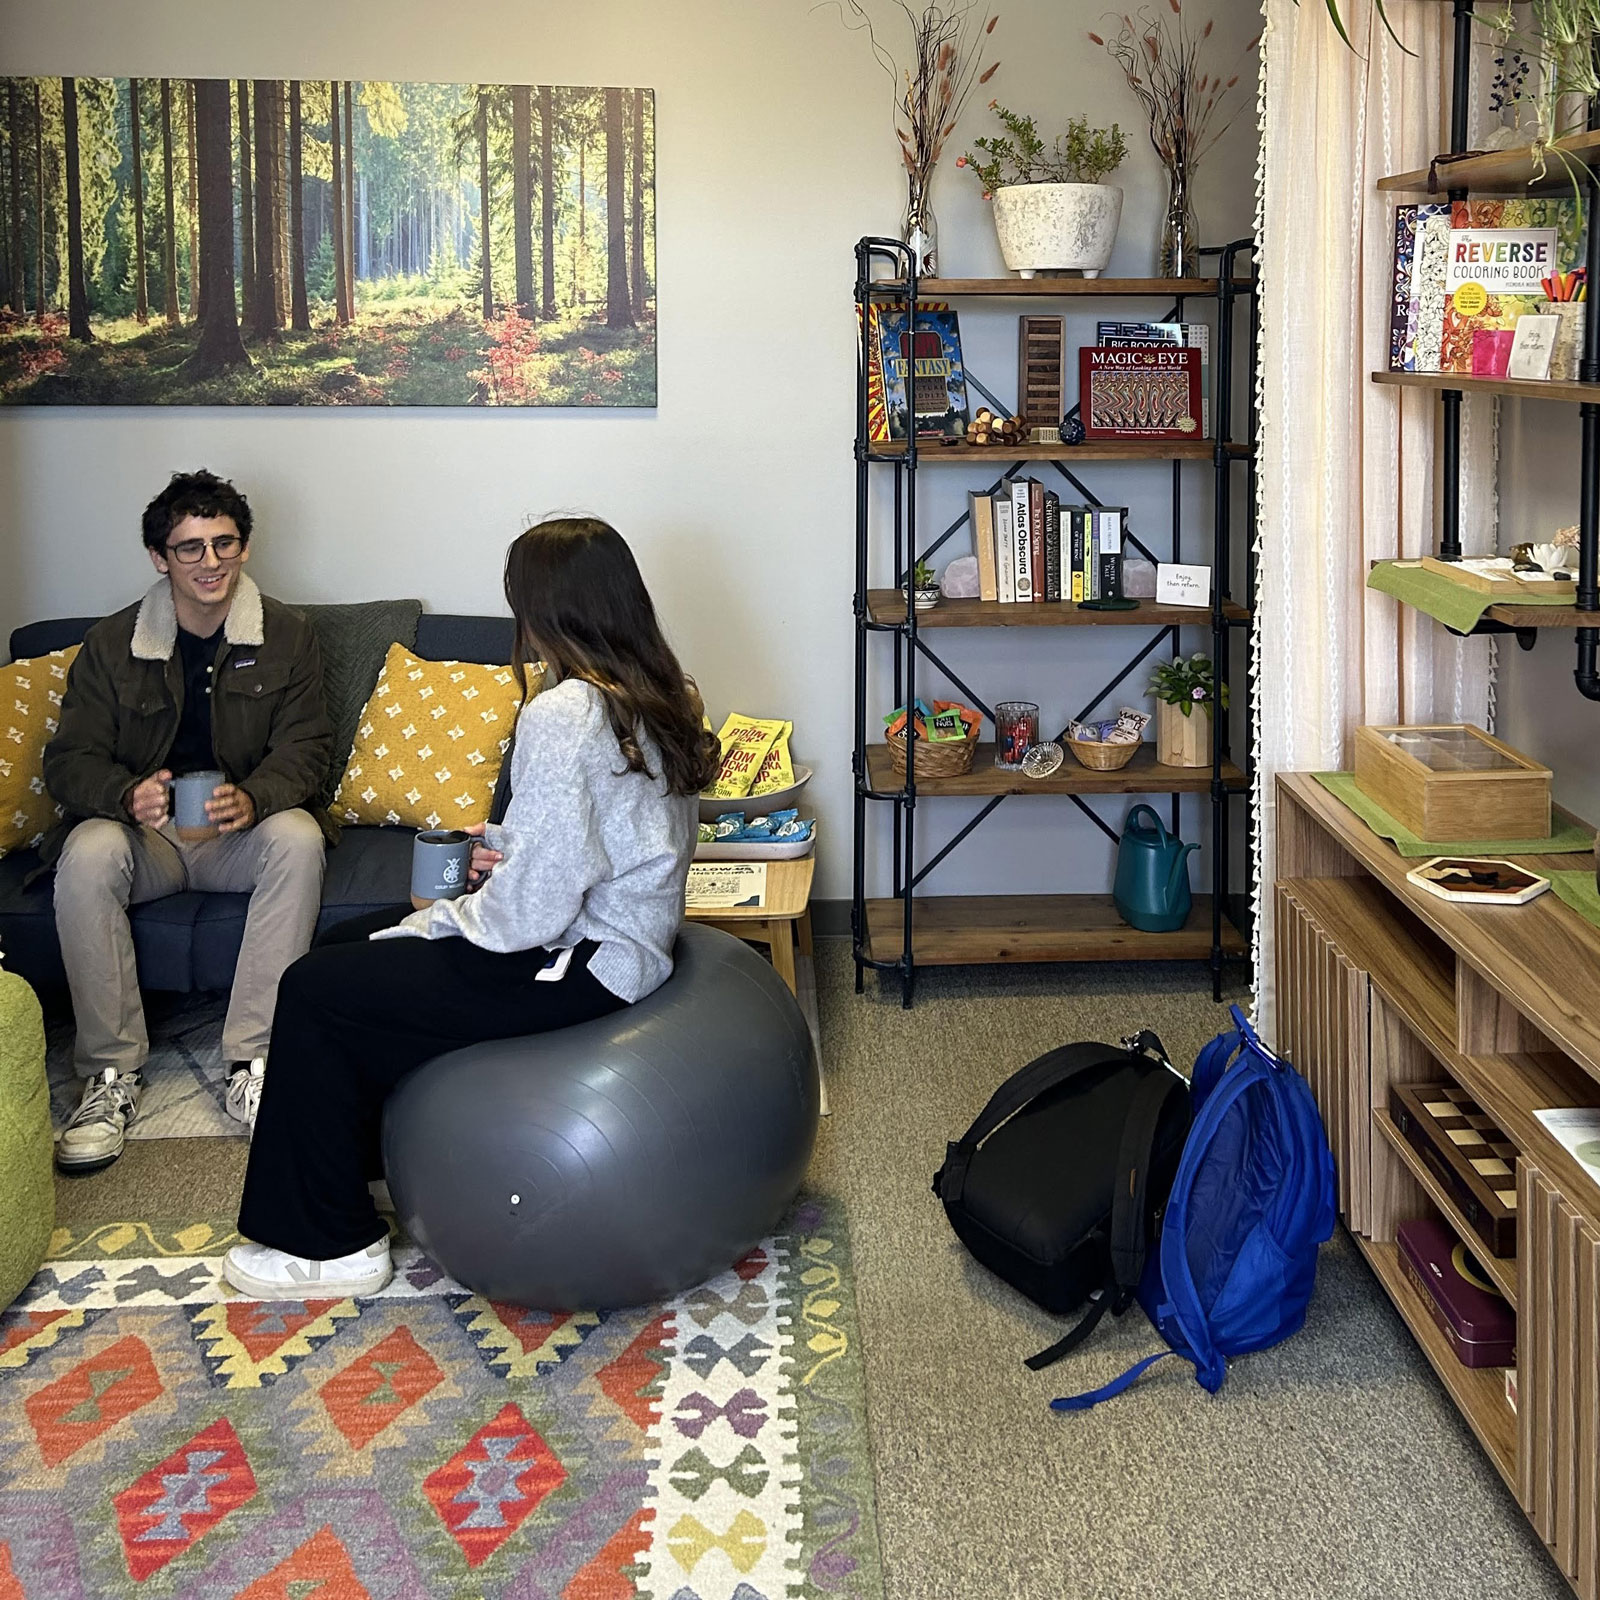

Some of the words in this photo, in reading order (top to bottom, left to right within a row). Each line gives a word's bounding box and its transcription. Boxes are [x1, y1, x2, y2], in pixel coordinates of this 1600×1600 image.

[1455, 242, 1548, 262] REVERSE
[1453, 265, 1509, 279] COLORING
[1513, 265, 1547, 278] BOOK
[1091, 352, 1142, 364] MAGIC
[1158, 352, 1189, 364] EYE
[1017, 502, 1027, 528] Atlas
[1018, 530, 1027, 574] Obscura
[1120, 711, 1147, 724] MADE
[730, 727, 768, 740] BOOM
[725, 749, 756, 763] OOM
[720, 759, 749, 773] ICKA
[761, 762, 781, 771] CKA
